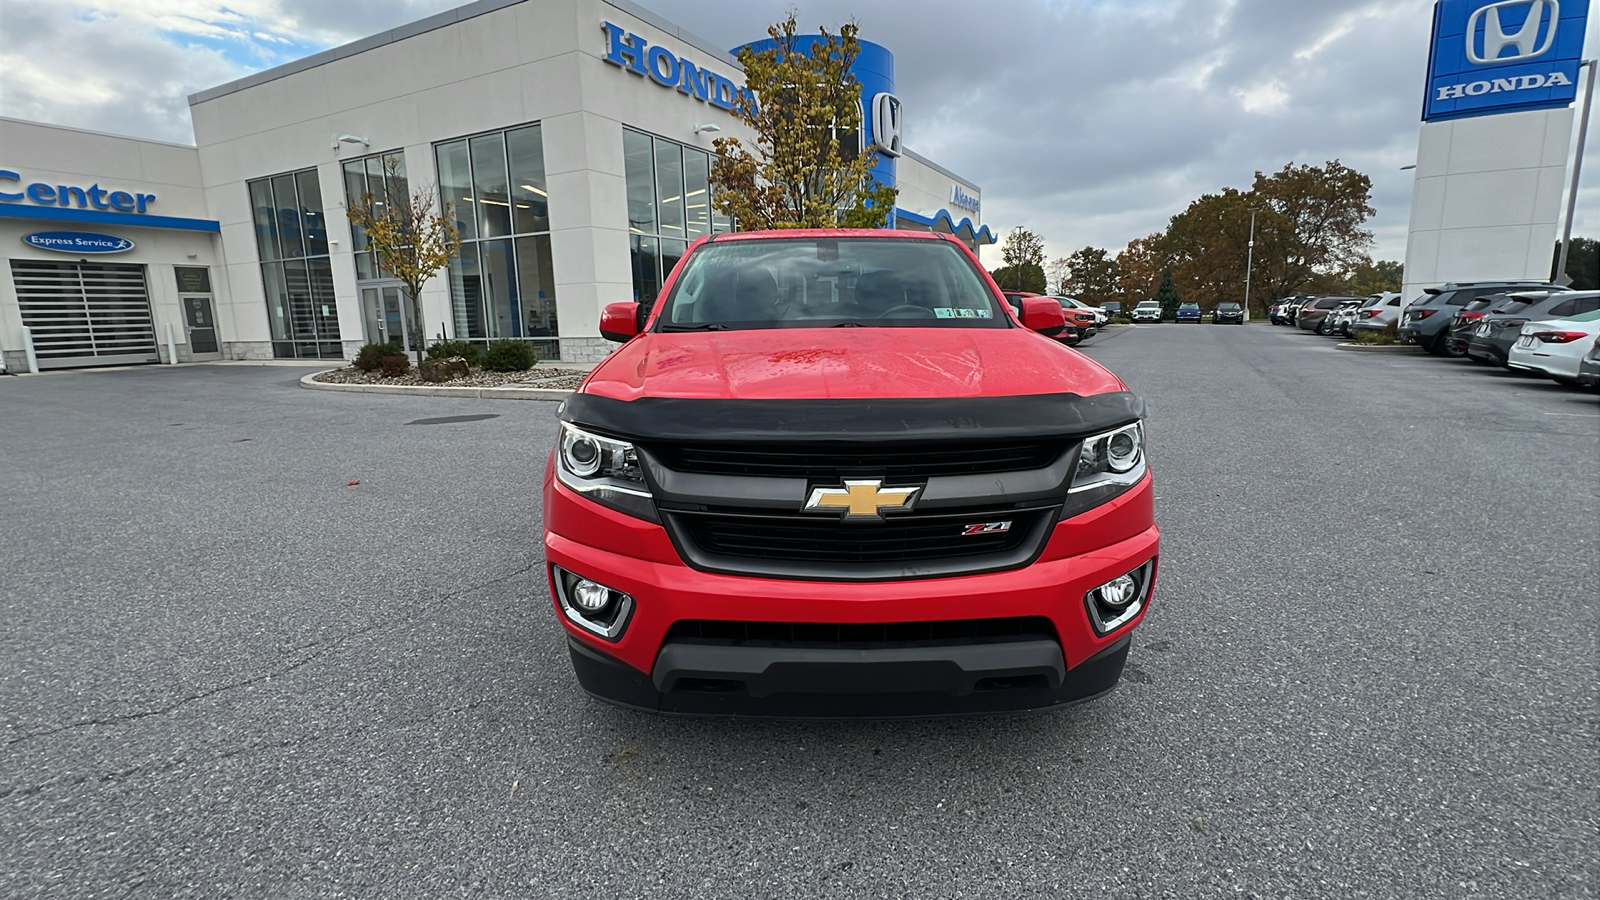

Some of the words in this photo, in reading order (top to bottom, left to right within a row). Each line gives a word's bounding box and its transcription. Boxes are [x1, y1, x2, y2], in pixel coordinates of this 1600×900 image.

[1436, 71, 1572, 101] HONDA
[31, 236, 74, 246] Express
[75, 238, 113, 247] Service
[961, 521, 1012, 536] Z71
